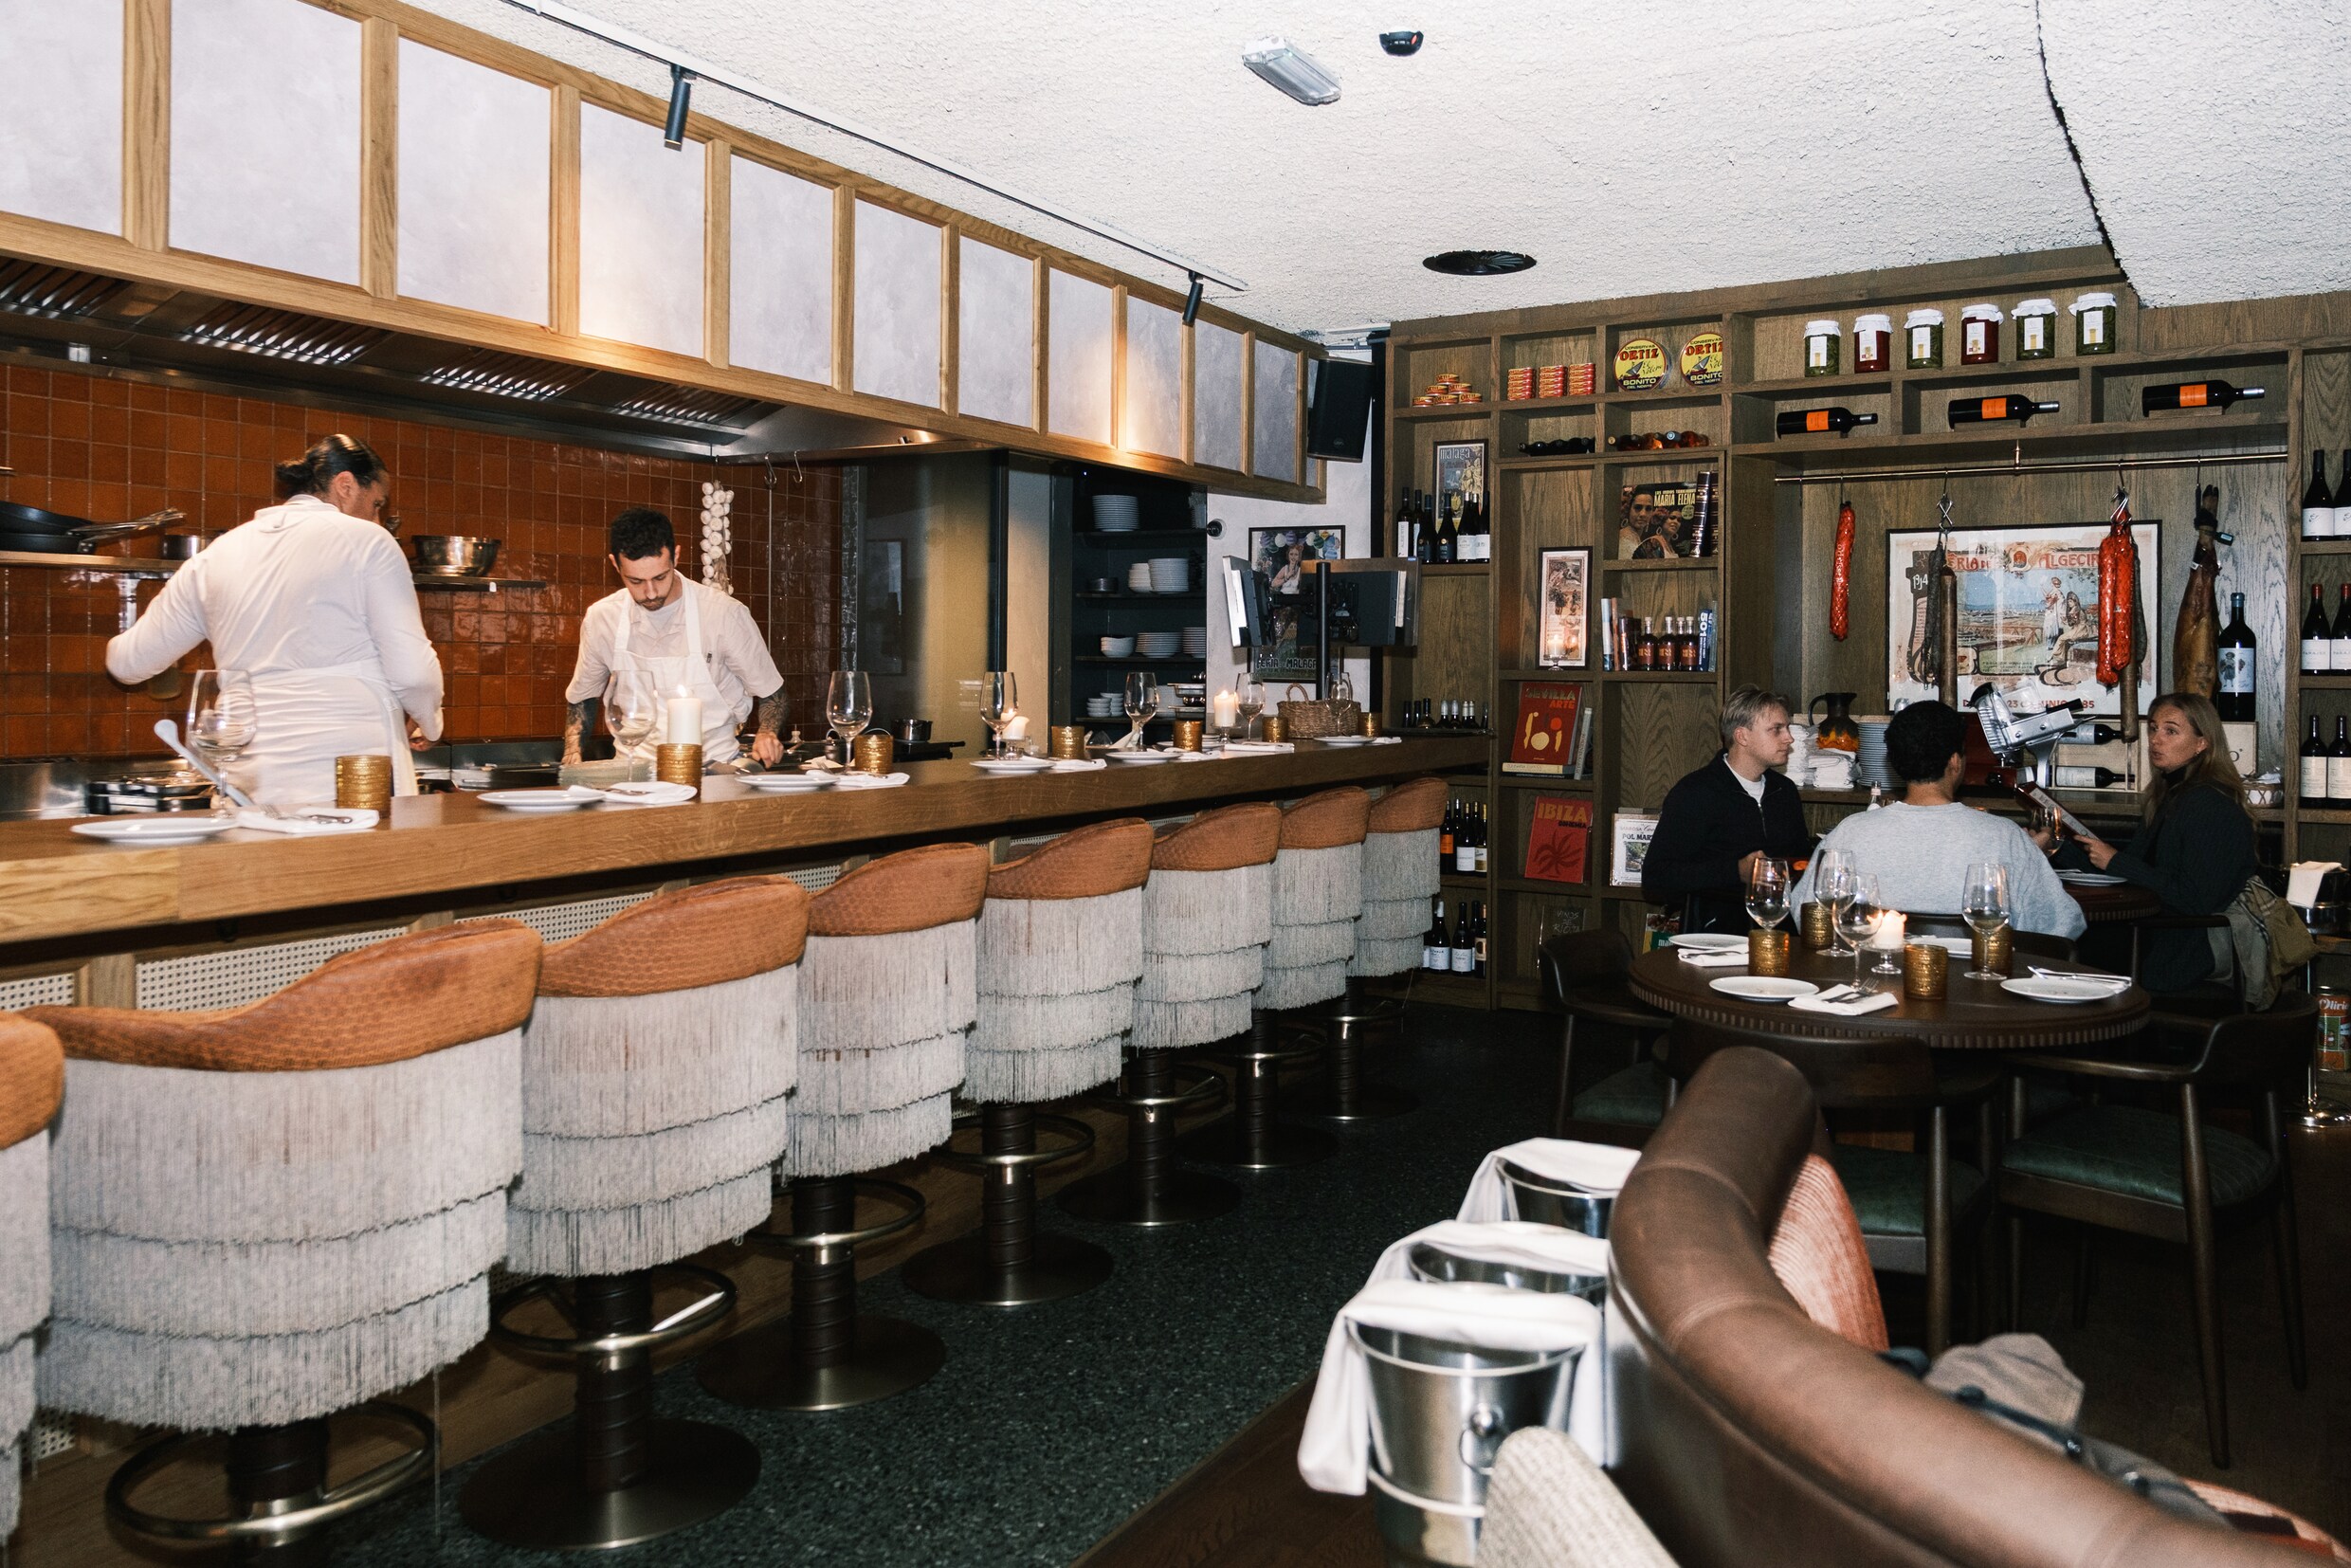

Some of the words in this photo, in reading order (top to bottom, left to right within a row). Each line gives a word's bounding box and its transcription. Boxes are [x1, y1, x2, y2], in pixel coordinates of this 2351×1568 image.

[1618, 348, 1659, 361] ORTIZ
[1686, 341, 1722, 356] ORTIZ
[1623, 377, 1657, 386] BONITO
[1654, 493, 1675, 506] MARIA
[1677, 492, 1695, 505] ELENA
[2038, 553, 2099, 569] ALGECIR
[1700, 612, 1708, 636] 501
[1549, 700, 1575, 709] ARTE
[1538, 802, 1588, 822] IBIZA
